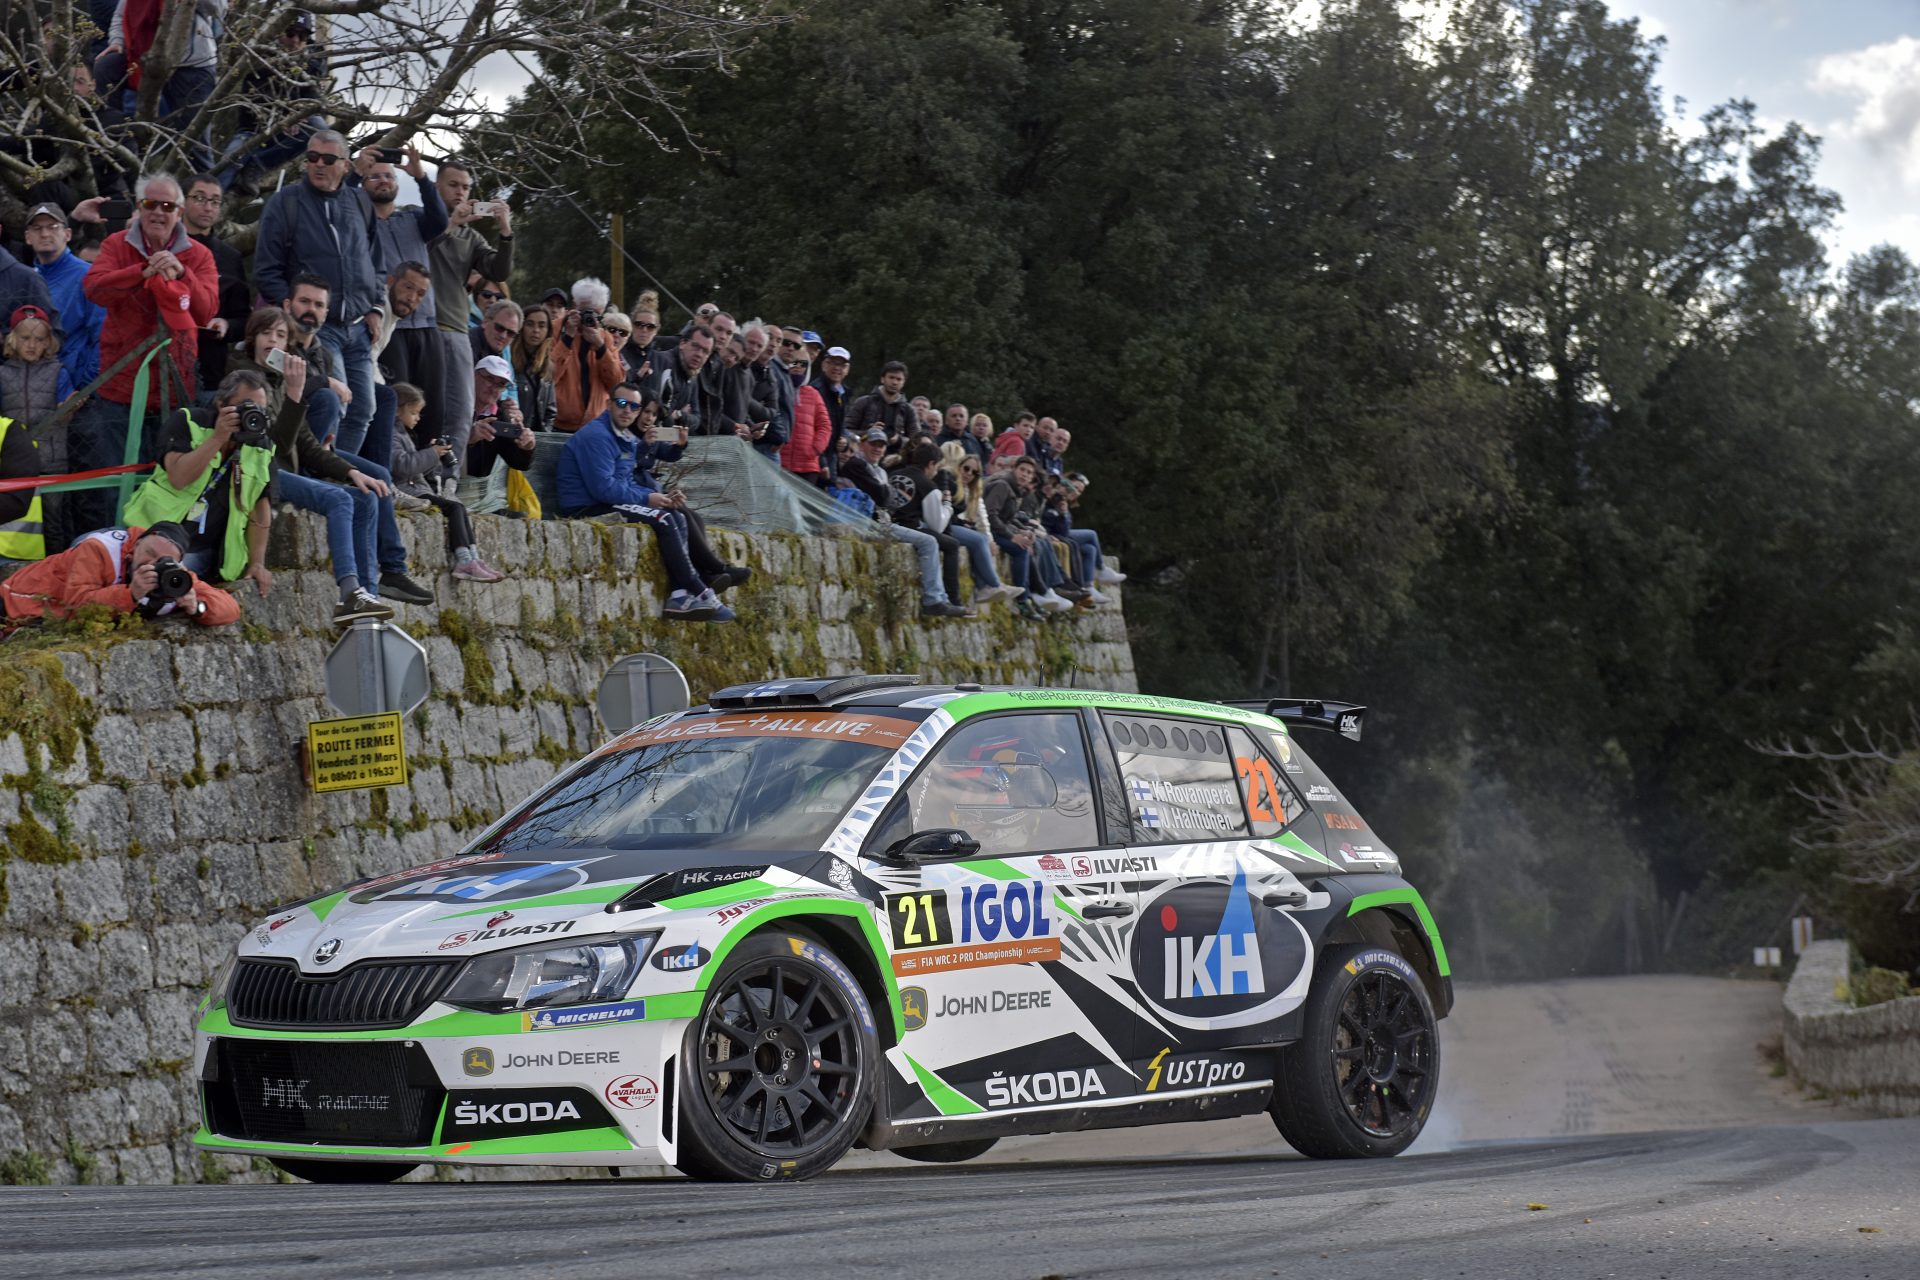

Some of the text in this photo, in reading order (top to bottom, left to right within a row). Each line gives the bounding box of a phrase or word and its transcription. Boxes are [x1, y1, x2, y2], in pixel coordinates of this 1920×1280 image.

[315, 720, 394, 737] Tour de Corse WRC 2019
[760, 718, 807, 731] ALL
[811, 719, 873, 736] LIVE
[1340, 714, 1358, 728] HK
[317, 734, 395, 754] ROUTE FERMEE
[317, 752, 398, 769] Vendredi 29 Mars
[318, 773, 329, 784] de
[331, 770, 357, 782] 08h02
[1235, 756, 1287, 824] 21
[682, 869, 761, 884] HK RACING
[898, 880, 1050, 945] 21 IGOL
[921, 956, 934, 968] FIA
[935, 954, 951, 966] WRC
[952, 953, 958, 964] 2
[959, 951, 974, 963] PRO
[975, 947, 1023, 961] Championship
[1364, 953, 1411, 977] MICHELIN
[556, 1007, 635, 1025] MICHELIN
[263, 1076, 312, 1110] HK
[618, 1087, 652, 1096] VAHALA
[985, 1068, 1107, 1107] ŠKODA
[454, 1100, 581, 1125] ŠKODA
